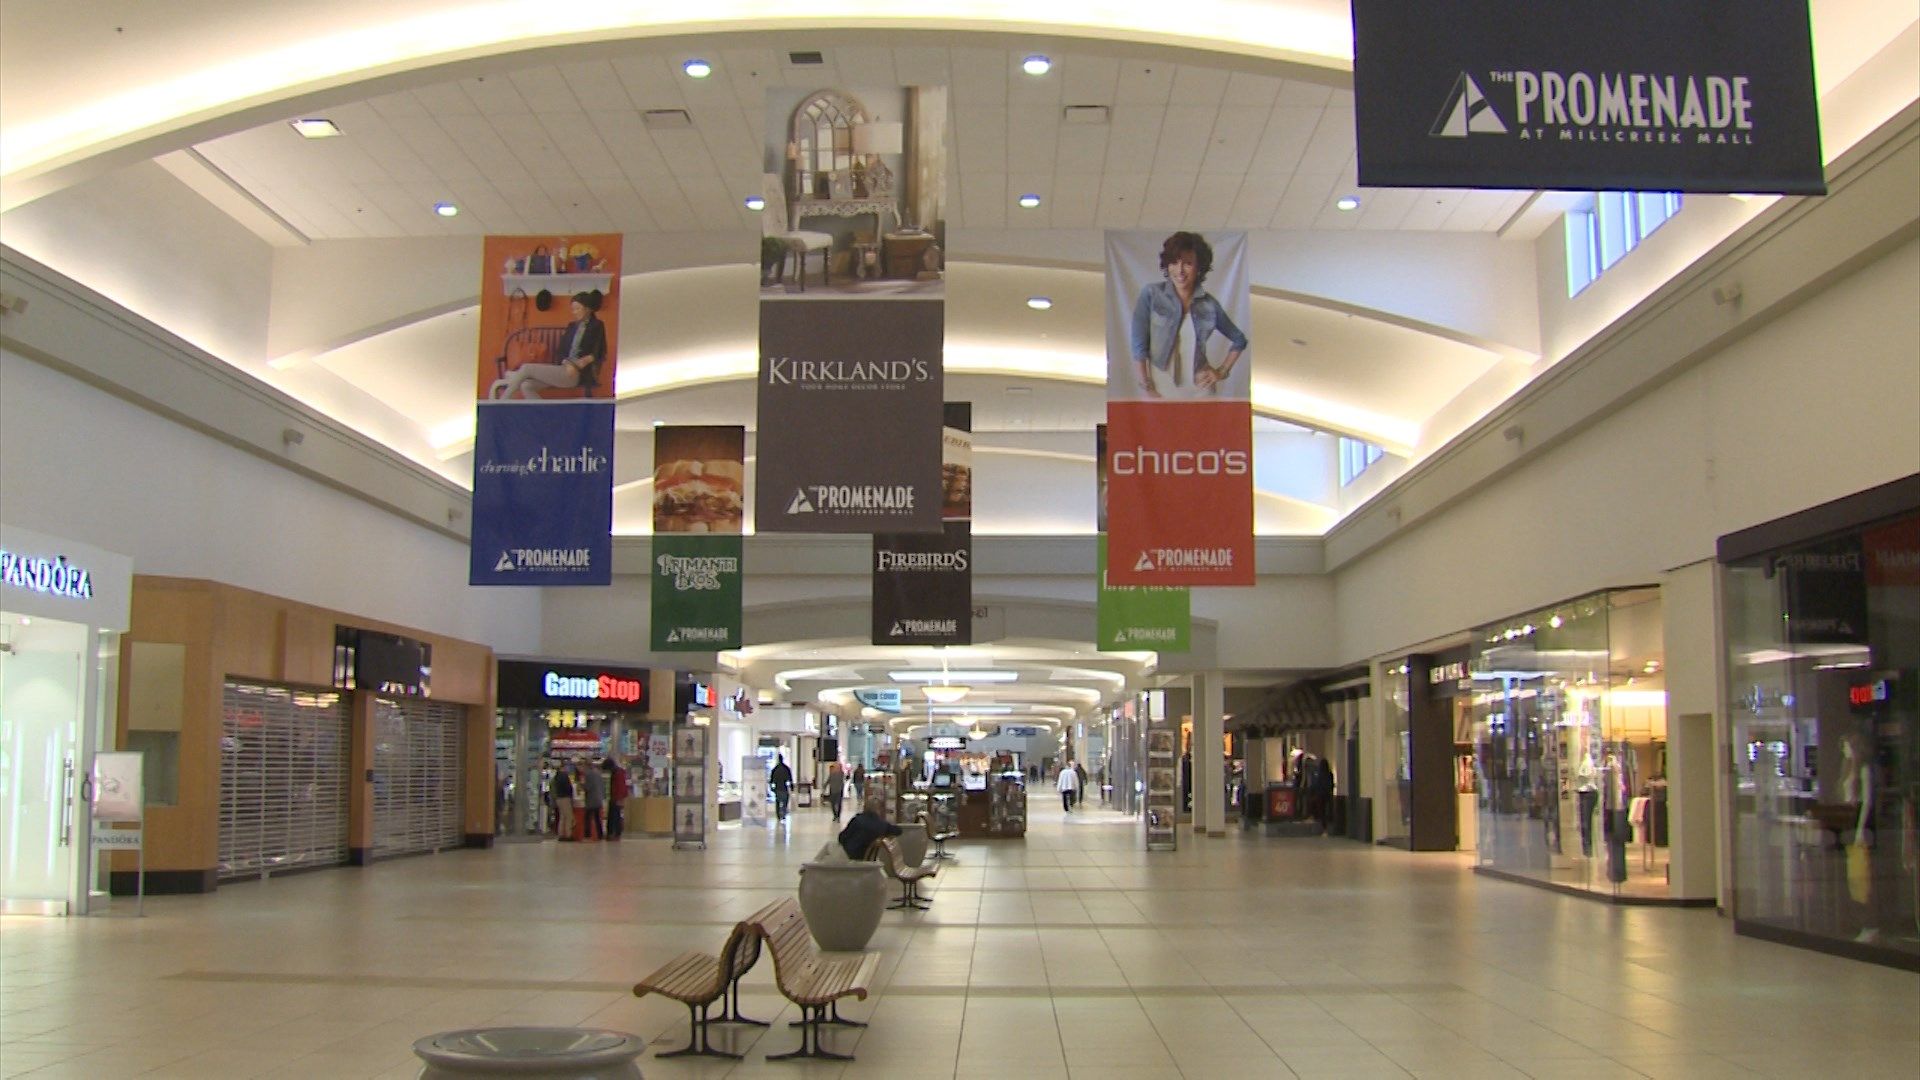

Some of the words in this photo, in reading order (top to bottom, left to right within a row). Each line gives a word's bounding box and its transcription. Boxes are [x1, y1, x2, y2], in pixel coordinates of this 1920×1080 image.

[1490, 71, 1514, 82] THE
[1515, 71, 1753, 129] PROMENADE
[1519, 129, 1544, 140] AT
[1559, 129, 1681, 144] MILLCREEK
[1697, 133, 1753, 145] MALL
[768, 357, 929, 385] KIRKLAND'S
[1113, 445, 1247, 475] chico's
[818, 485, 914, 508] PROMENADE
[516, 549, 590, 566] PROMENADE
[878, 549, 968, 572] FIREBIRDS
[1157, 548, 1232, 566] PROMENADE
[0, 550, 93, 599] PANDORA
[680, 627, 728, 639] PROMENADE
[905, 619, 957, 632] PROMENADE
[1127, 627, 1176, 640] PROMENADE
[545, 671, 640, 702] GameStop
[92, 836, 140, 845] PANDORA
